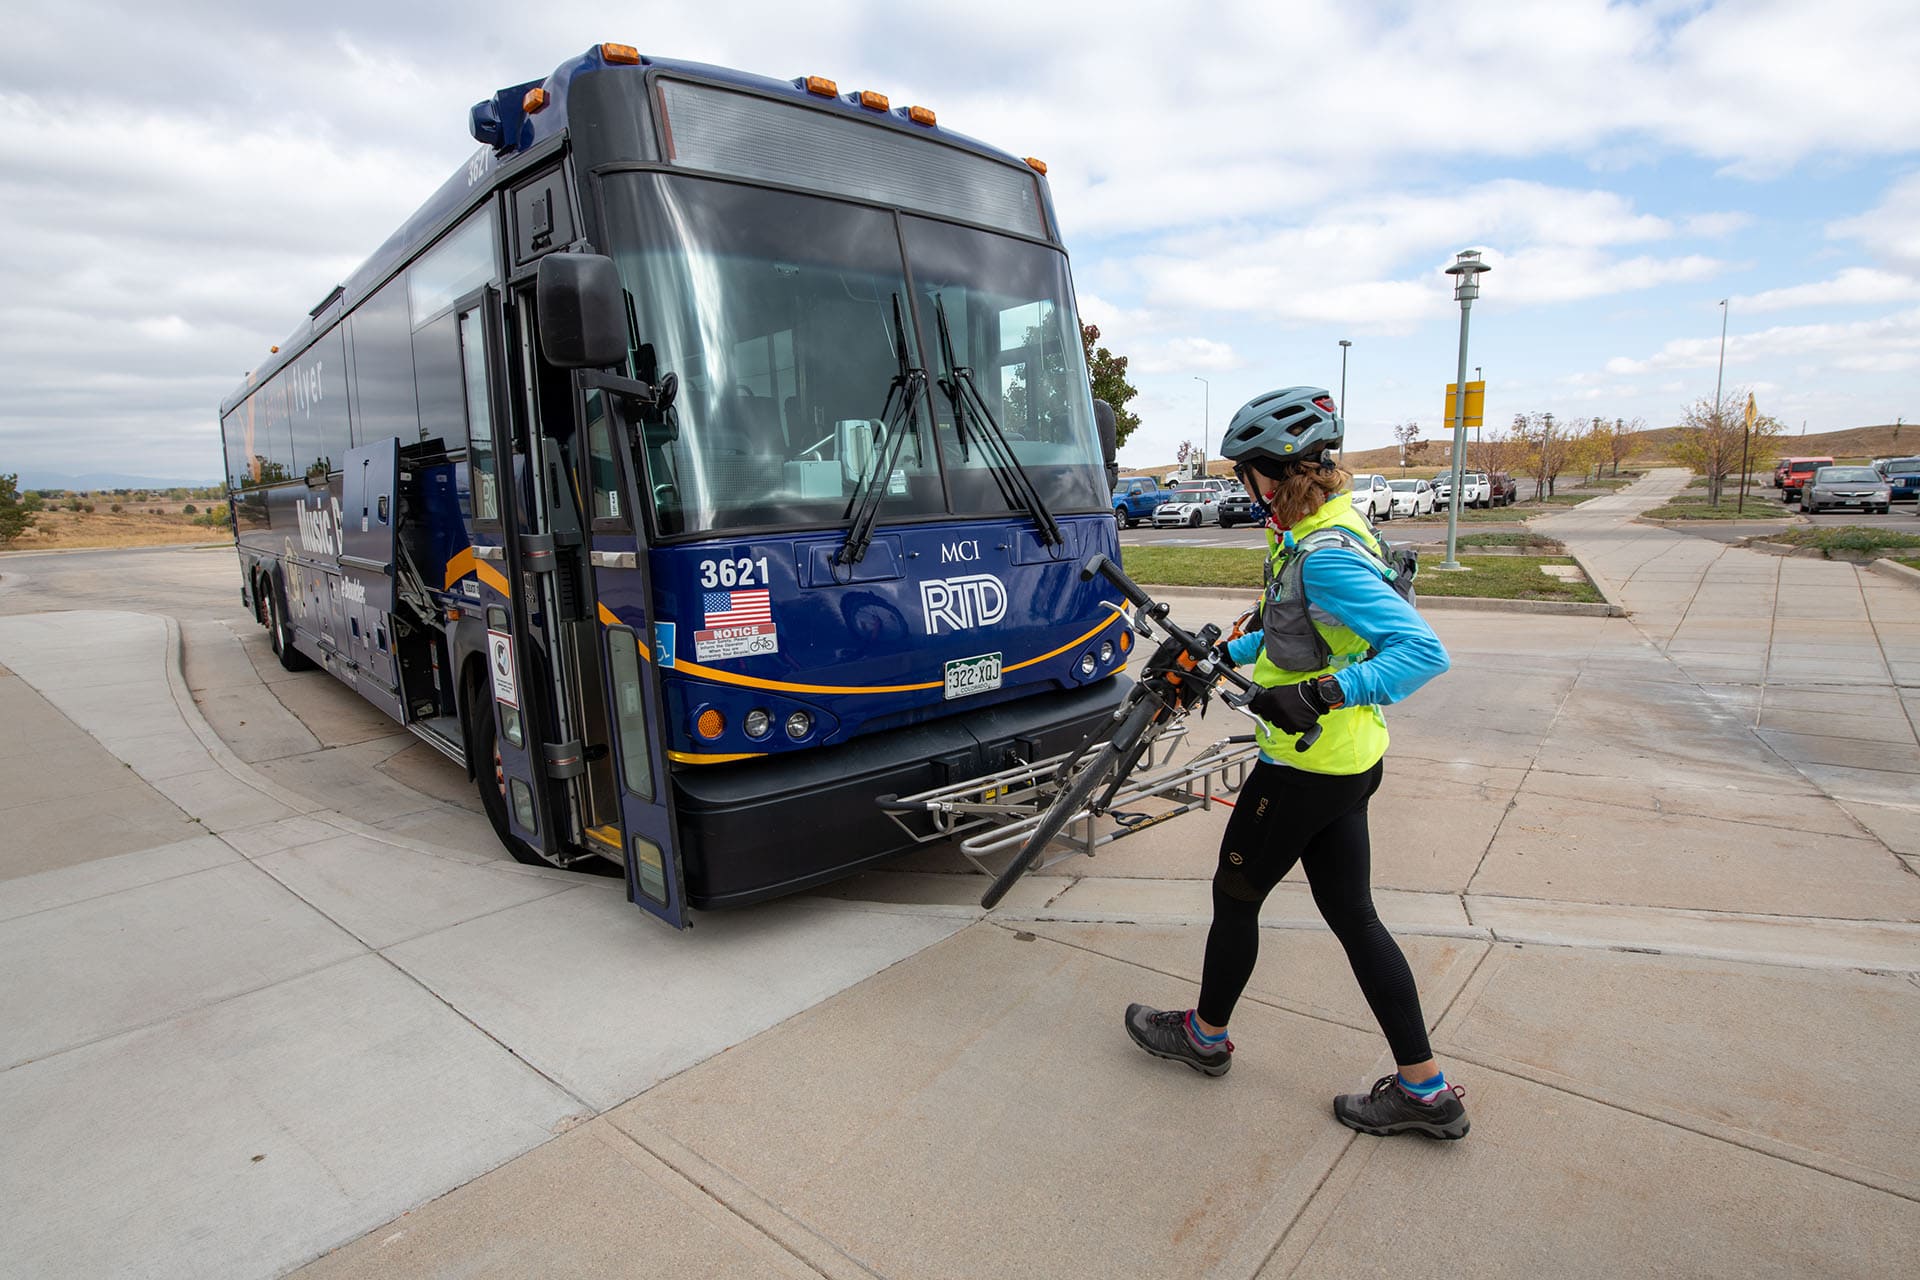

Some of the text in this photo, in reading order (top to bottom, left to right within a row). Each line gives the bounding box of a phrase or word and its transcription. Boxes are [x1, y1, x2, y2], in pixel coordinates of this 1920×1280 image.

[467, 148, 489, 187] 3621
[292, 359, 323, 419] flyer
[296, 497, 333, 555] Music
[941, 540, 981, 564] MCI
[700, 557, 769, 589] 3621
[920, 573, 1008, 635] RTD
[713, 626, 760, 639] NOTICE
